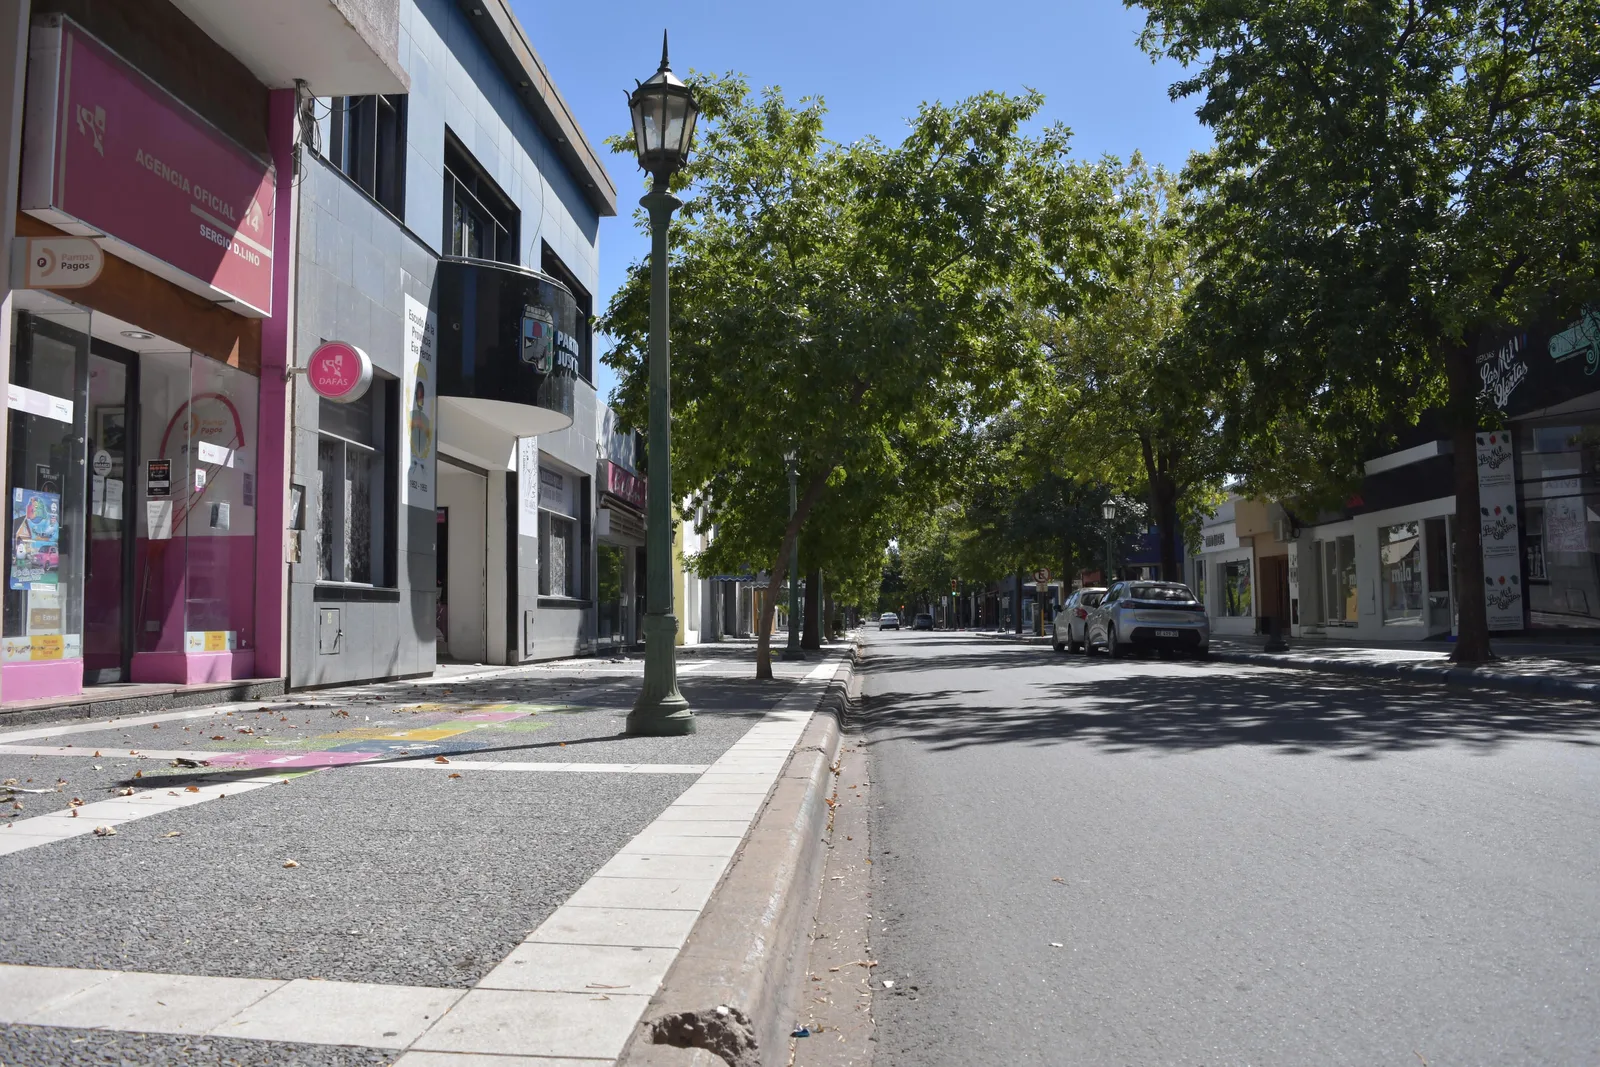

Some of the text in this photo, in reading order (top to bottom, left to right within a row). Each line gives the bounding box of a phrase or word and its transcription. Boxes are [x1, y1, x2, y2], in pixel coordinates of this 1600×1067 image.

[136, 148, 237, 221] AGENCIA OFICIAL
[200, 224, 260, 266] SERGIO D.LINO
[61, 253, 94, 262] Pampa
[61, 262, 90, 271] Pagos
[408, 308, 435, 336] Escudo de la
[412, 326, 431, 348] Provincia
[411, 340, 432, 362] Eva Perón
[1480, 339, 1515, 393] Las Mil
[319, 377, 348, 386] DAFAS
[1494, 361, 1528, 409] Ofertas
[201, 426, 223, 434] Pagos
[1478, 445, 1503, 467] Las Mil
[1483, 516, 1507, 537] Las Mil
[1039, 569, 1045, 580] E
[1391, 560, 1412, 583] mila
